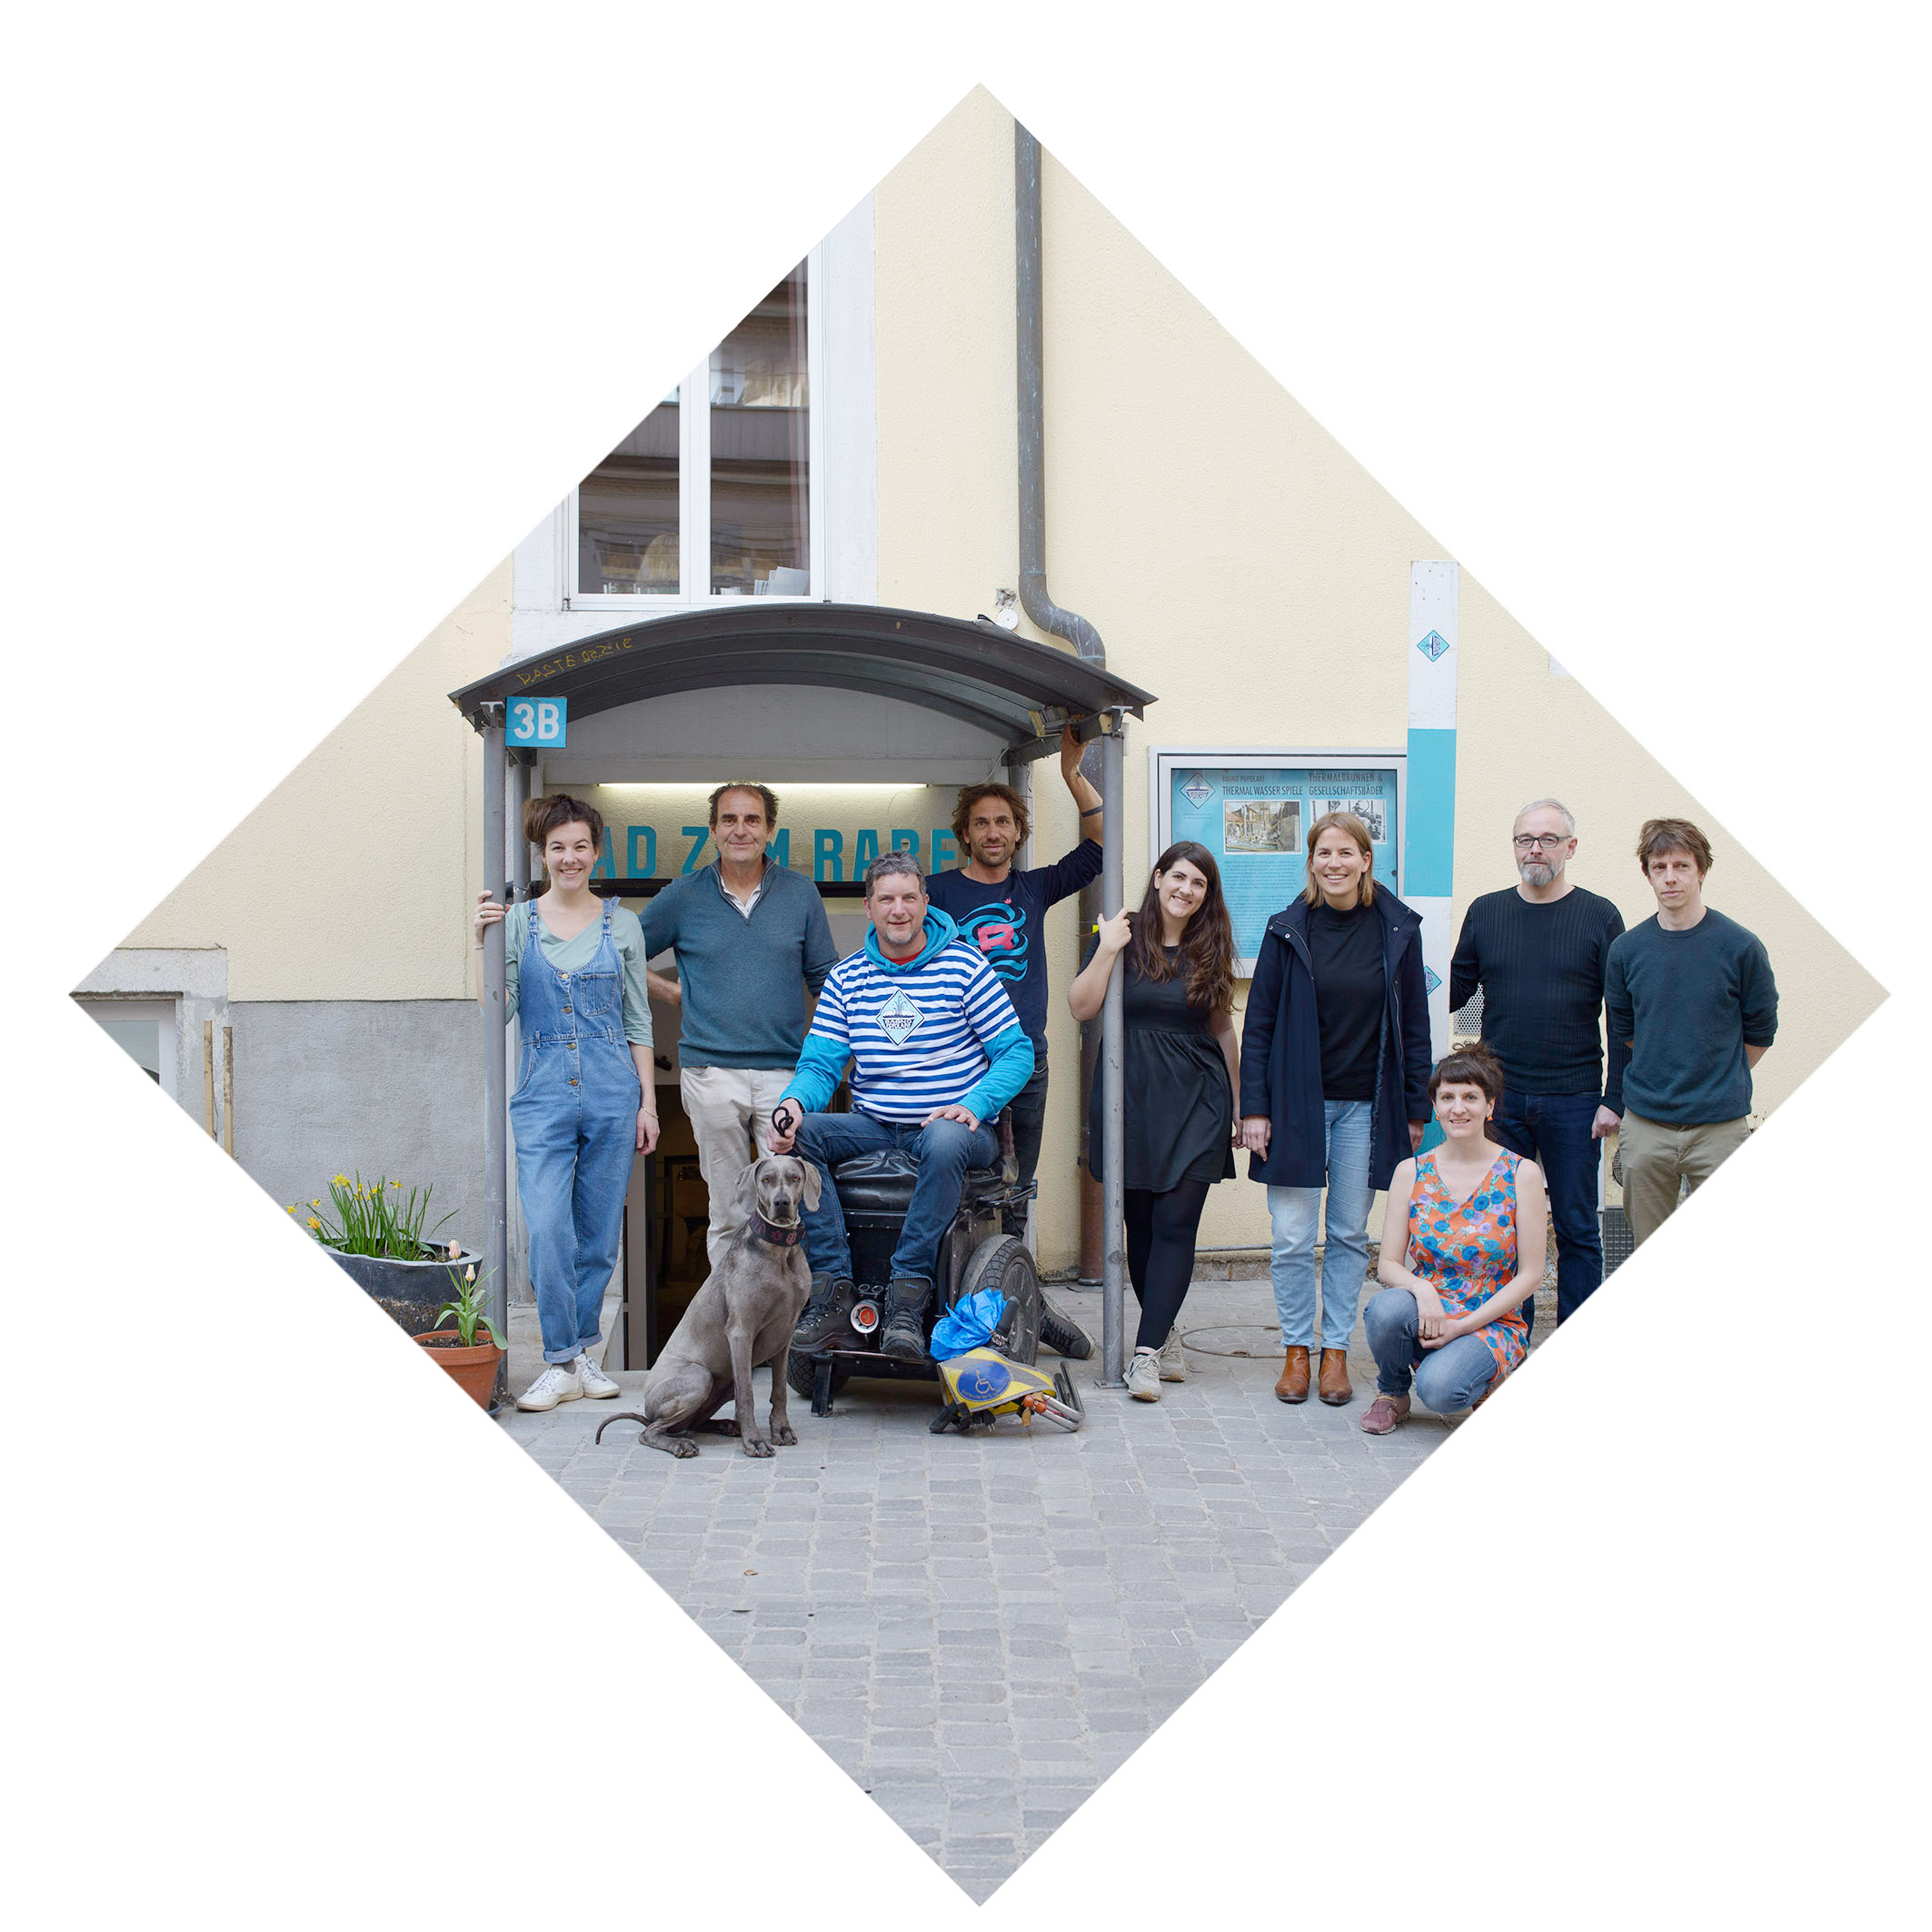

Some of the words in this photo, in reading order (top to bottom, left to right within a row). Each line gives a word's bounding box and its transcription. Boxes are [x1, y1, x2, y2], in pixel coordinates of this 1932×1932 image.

[513, 702, 560, 740] 3B
[1309, 772, 1374, 782] THERMALBRUNNEN
[1222, 785, 1252, 795] THERMAL
[1254, 785, 1280, 795] WASSER
[1281, 785, 1303, 795] SPIELE
[1309, 783, 1383, 795] GESELLSCHAFTSBÄDER
[589, 825, 657, 879] AD
